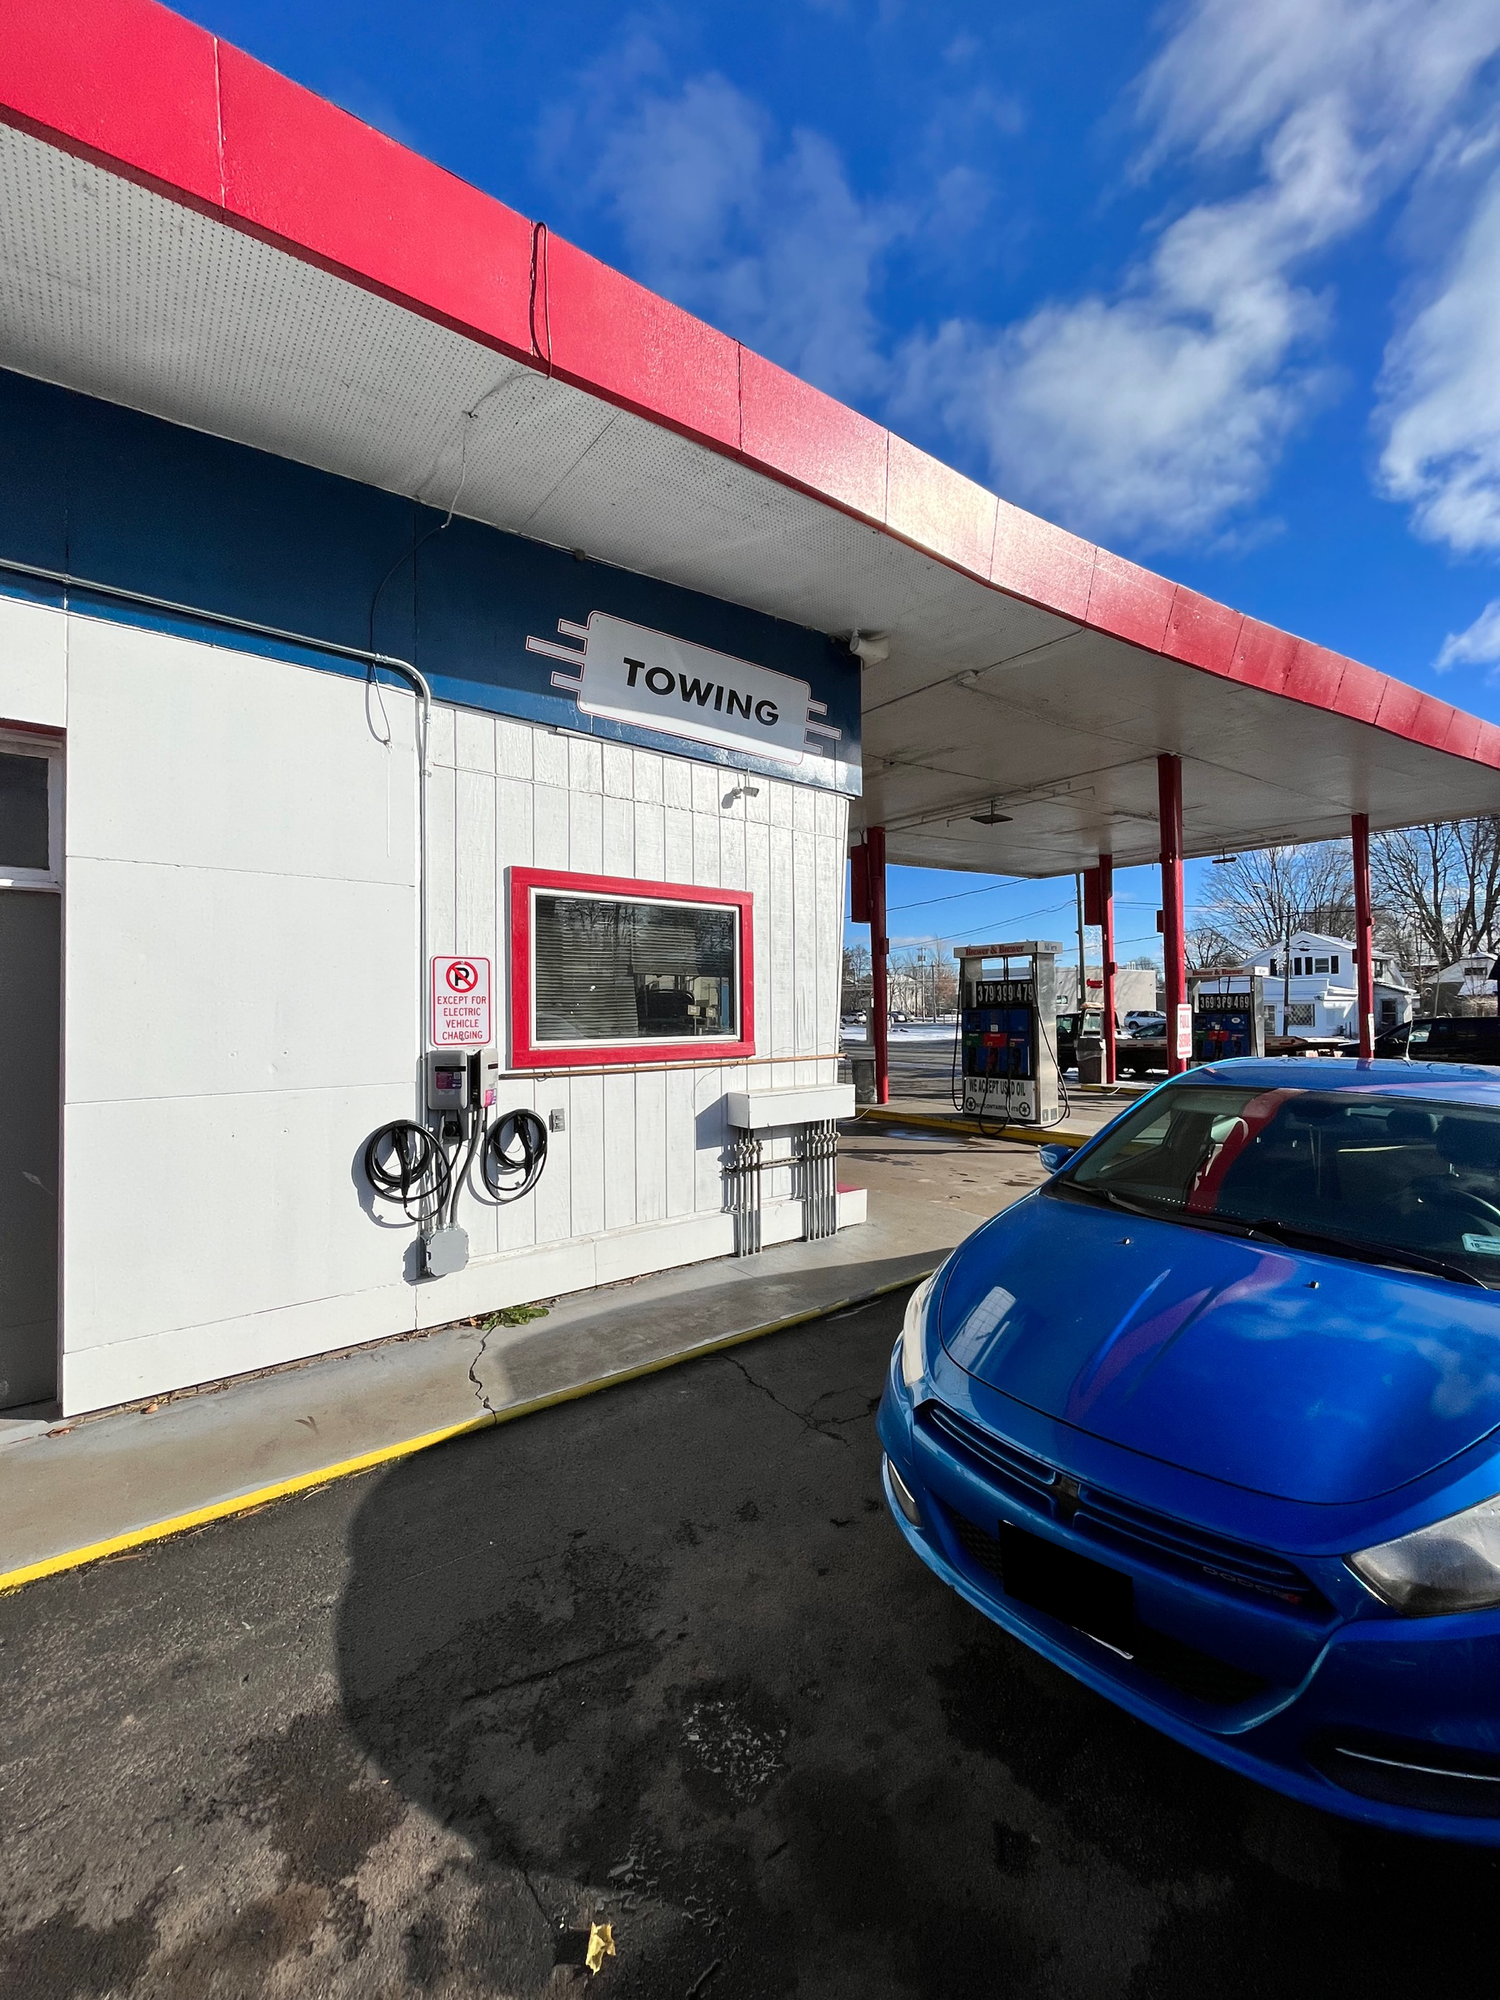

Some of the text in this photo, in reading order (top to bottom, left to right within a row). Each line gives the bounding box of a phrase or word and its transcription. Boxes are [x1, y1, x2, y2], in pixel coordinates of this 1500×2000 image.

[623, 657, 779, 726] TOWING
[437, 996, 487, 1005] EXCEPT FOR
[443, 1007, 481, 1017] ELECTRIC
[446, 1019, 479, 1028] VEHICLE
[442, 1030, 483, 1040] CHARGING
[969, 1078, 1026, 1096] WE ACEPT USD OIL
